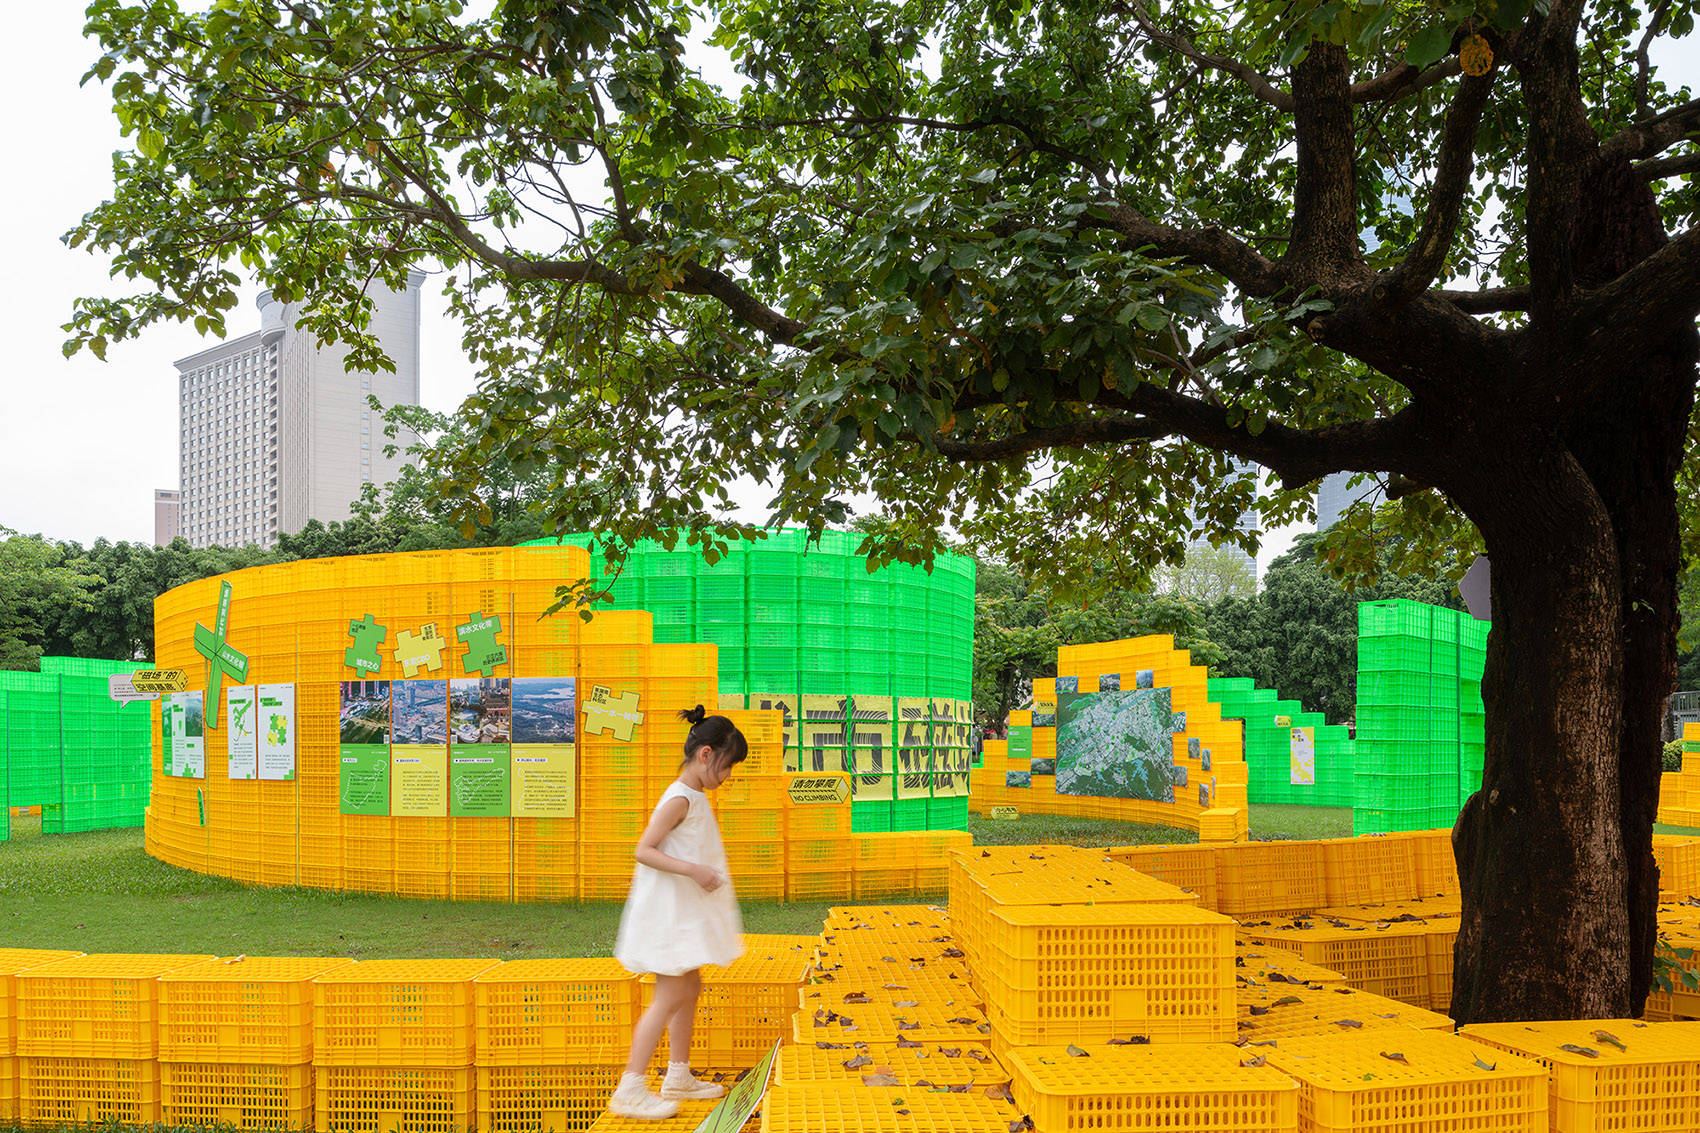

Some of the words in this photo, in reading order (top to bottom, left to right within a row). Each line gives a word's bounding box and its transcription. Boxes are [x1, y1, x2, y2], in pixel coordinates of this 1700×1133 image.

[458, 620, 492, 635] 滨水文化带
[356, 658, 379, 670] 城市之心
[404, 654, 430, 667] 东莞CBD
[138, 671, 178, 680] “磁场”的
[135, 683, 176, 691] 空间基底
[793, 779, 836, 788] 请勿攀爬
